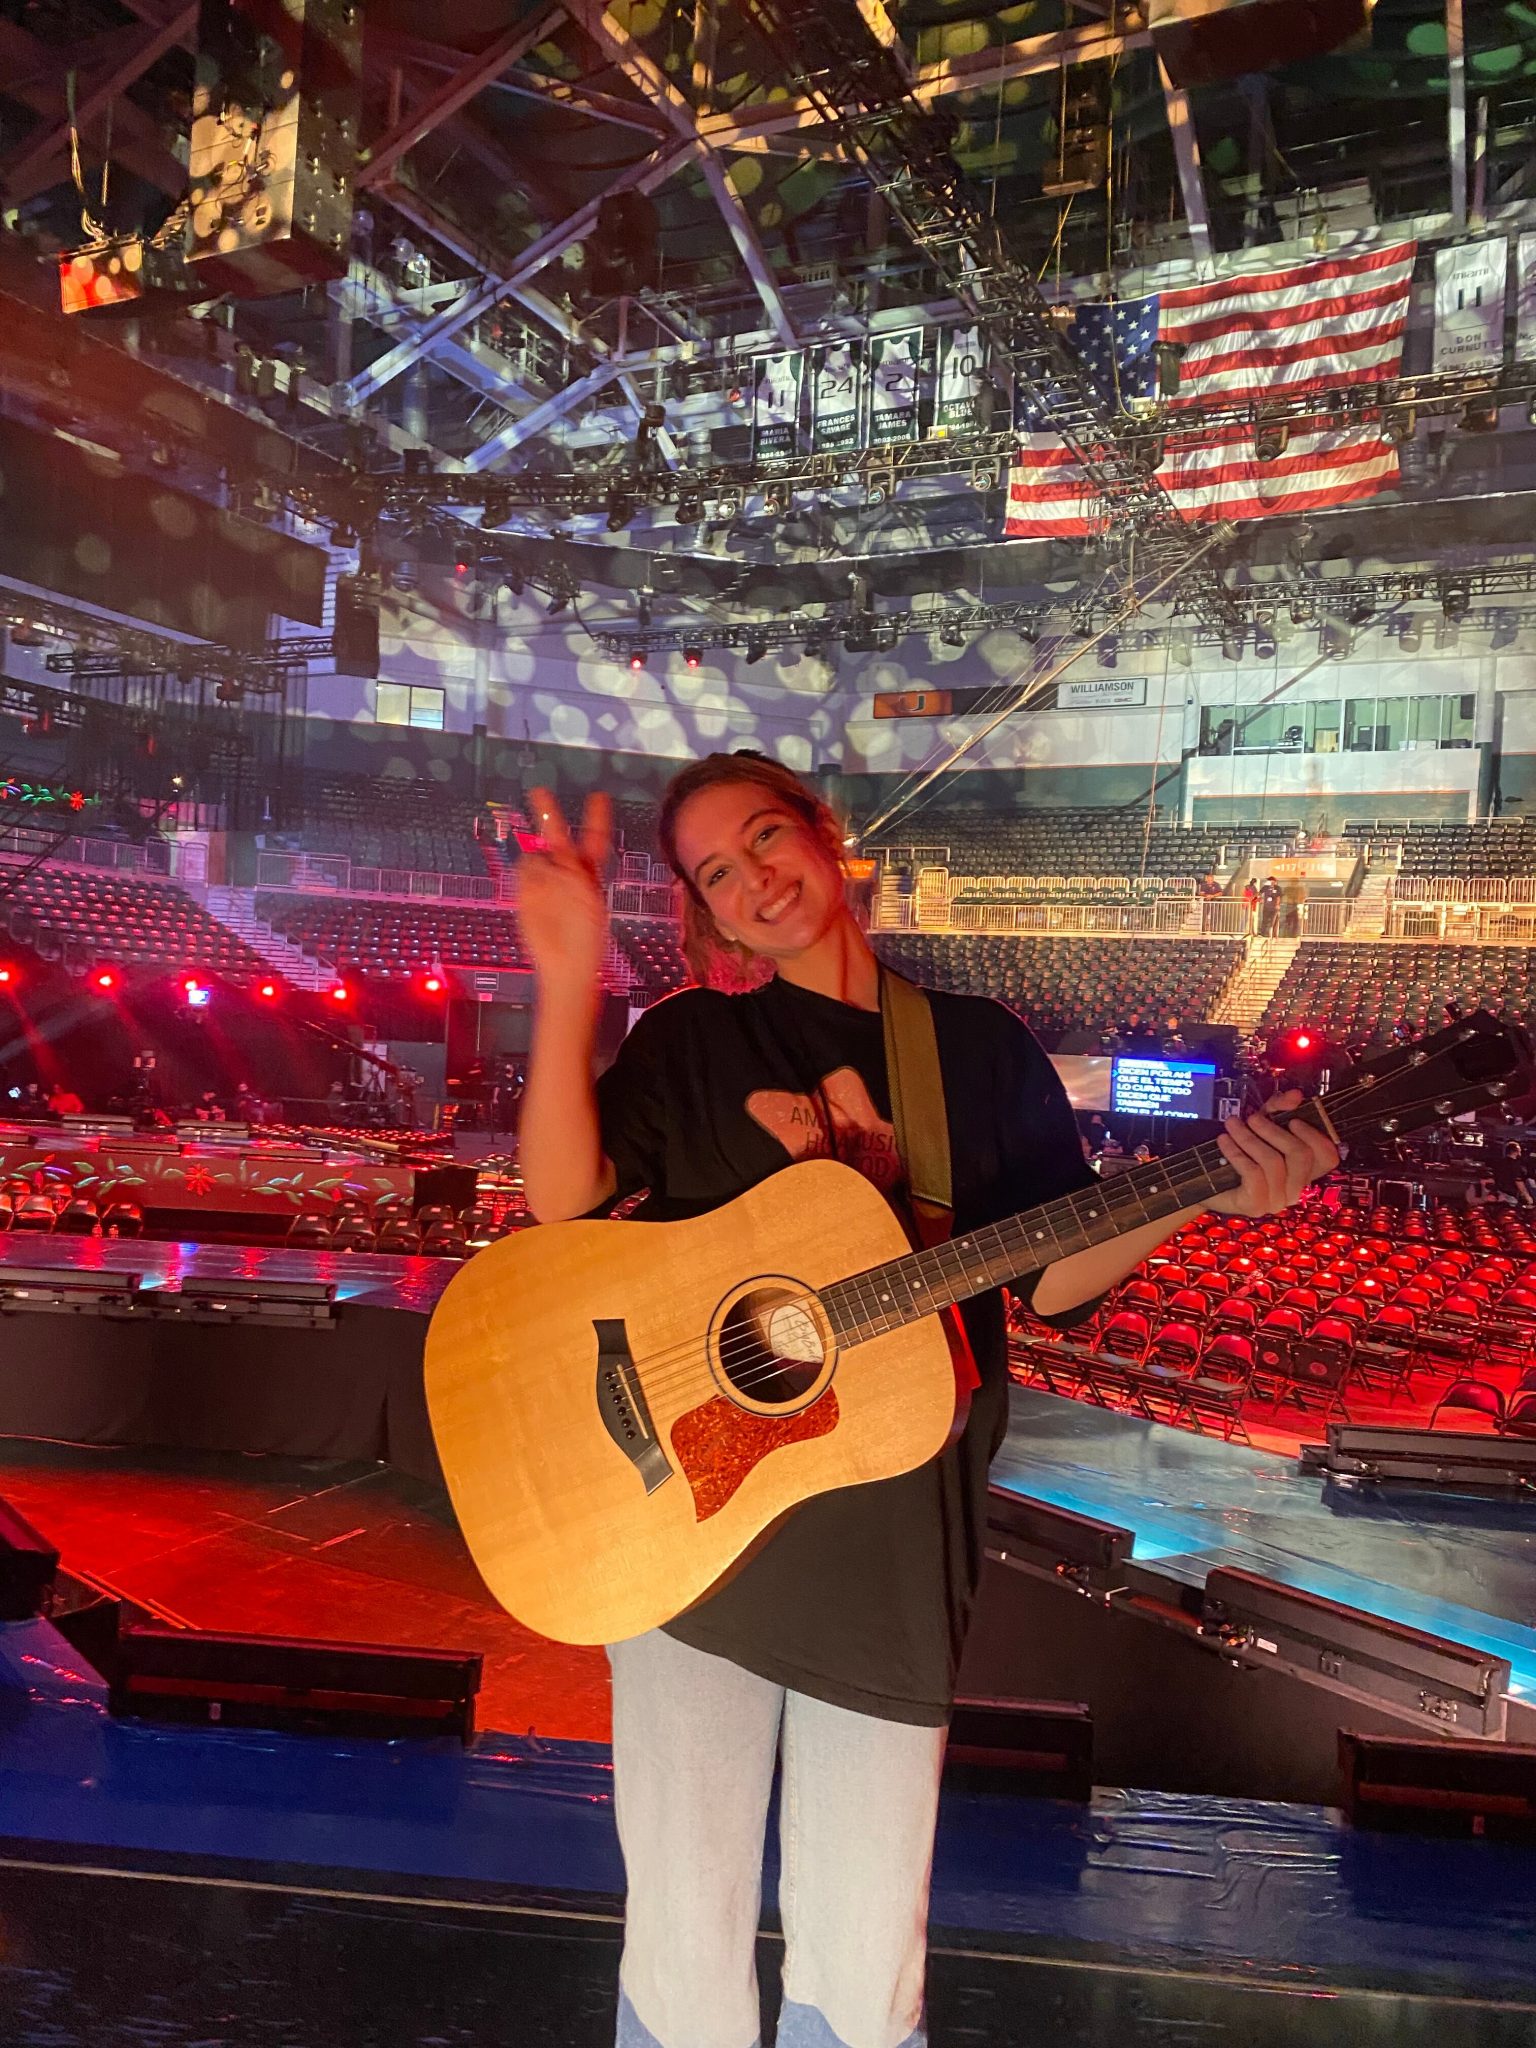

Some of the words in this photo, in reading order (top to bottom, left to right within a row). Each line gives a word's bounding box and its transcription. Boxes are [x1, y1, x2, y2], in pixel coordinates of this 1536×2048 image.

[1457, 285, 1483, 311] 11
[1456, 333, 1482, 345] DON
[1440, 340, 1497, 355] CURNUTT
[952, 354, 976, 379] 10
[820, 376, 854, 400] 24
[885, 373, 905, 392] 2
[874, 411, 911, 423] TAMARA
[948, 408, 973, 419] BLUE
[817, 414, 855, 429] FRANCES
[878, 419, 907, 430] JAMES
[820, 423, 852, 435] SAVAGE
[760, 434, 791, 446] RIVERA
[1071, 681, 1135, 694] WILLIAMSON
[1117, 1075, 1139, 1084] QUE
[1140, 1077, 1154, 1085] EL
[1154, 1078, 1195, 1088] TIEMPO
[1116, 1083, 1132, 1091] LO
[1131, 1084, 1161, 1093] CURA
[1161, 1086, 1192, 1096] TODO
[1148, 1094, 1171, 1103] QUE
